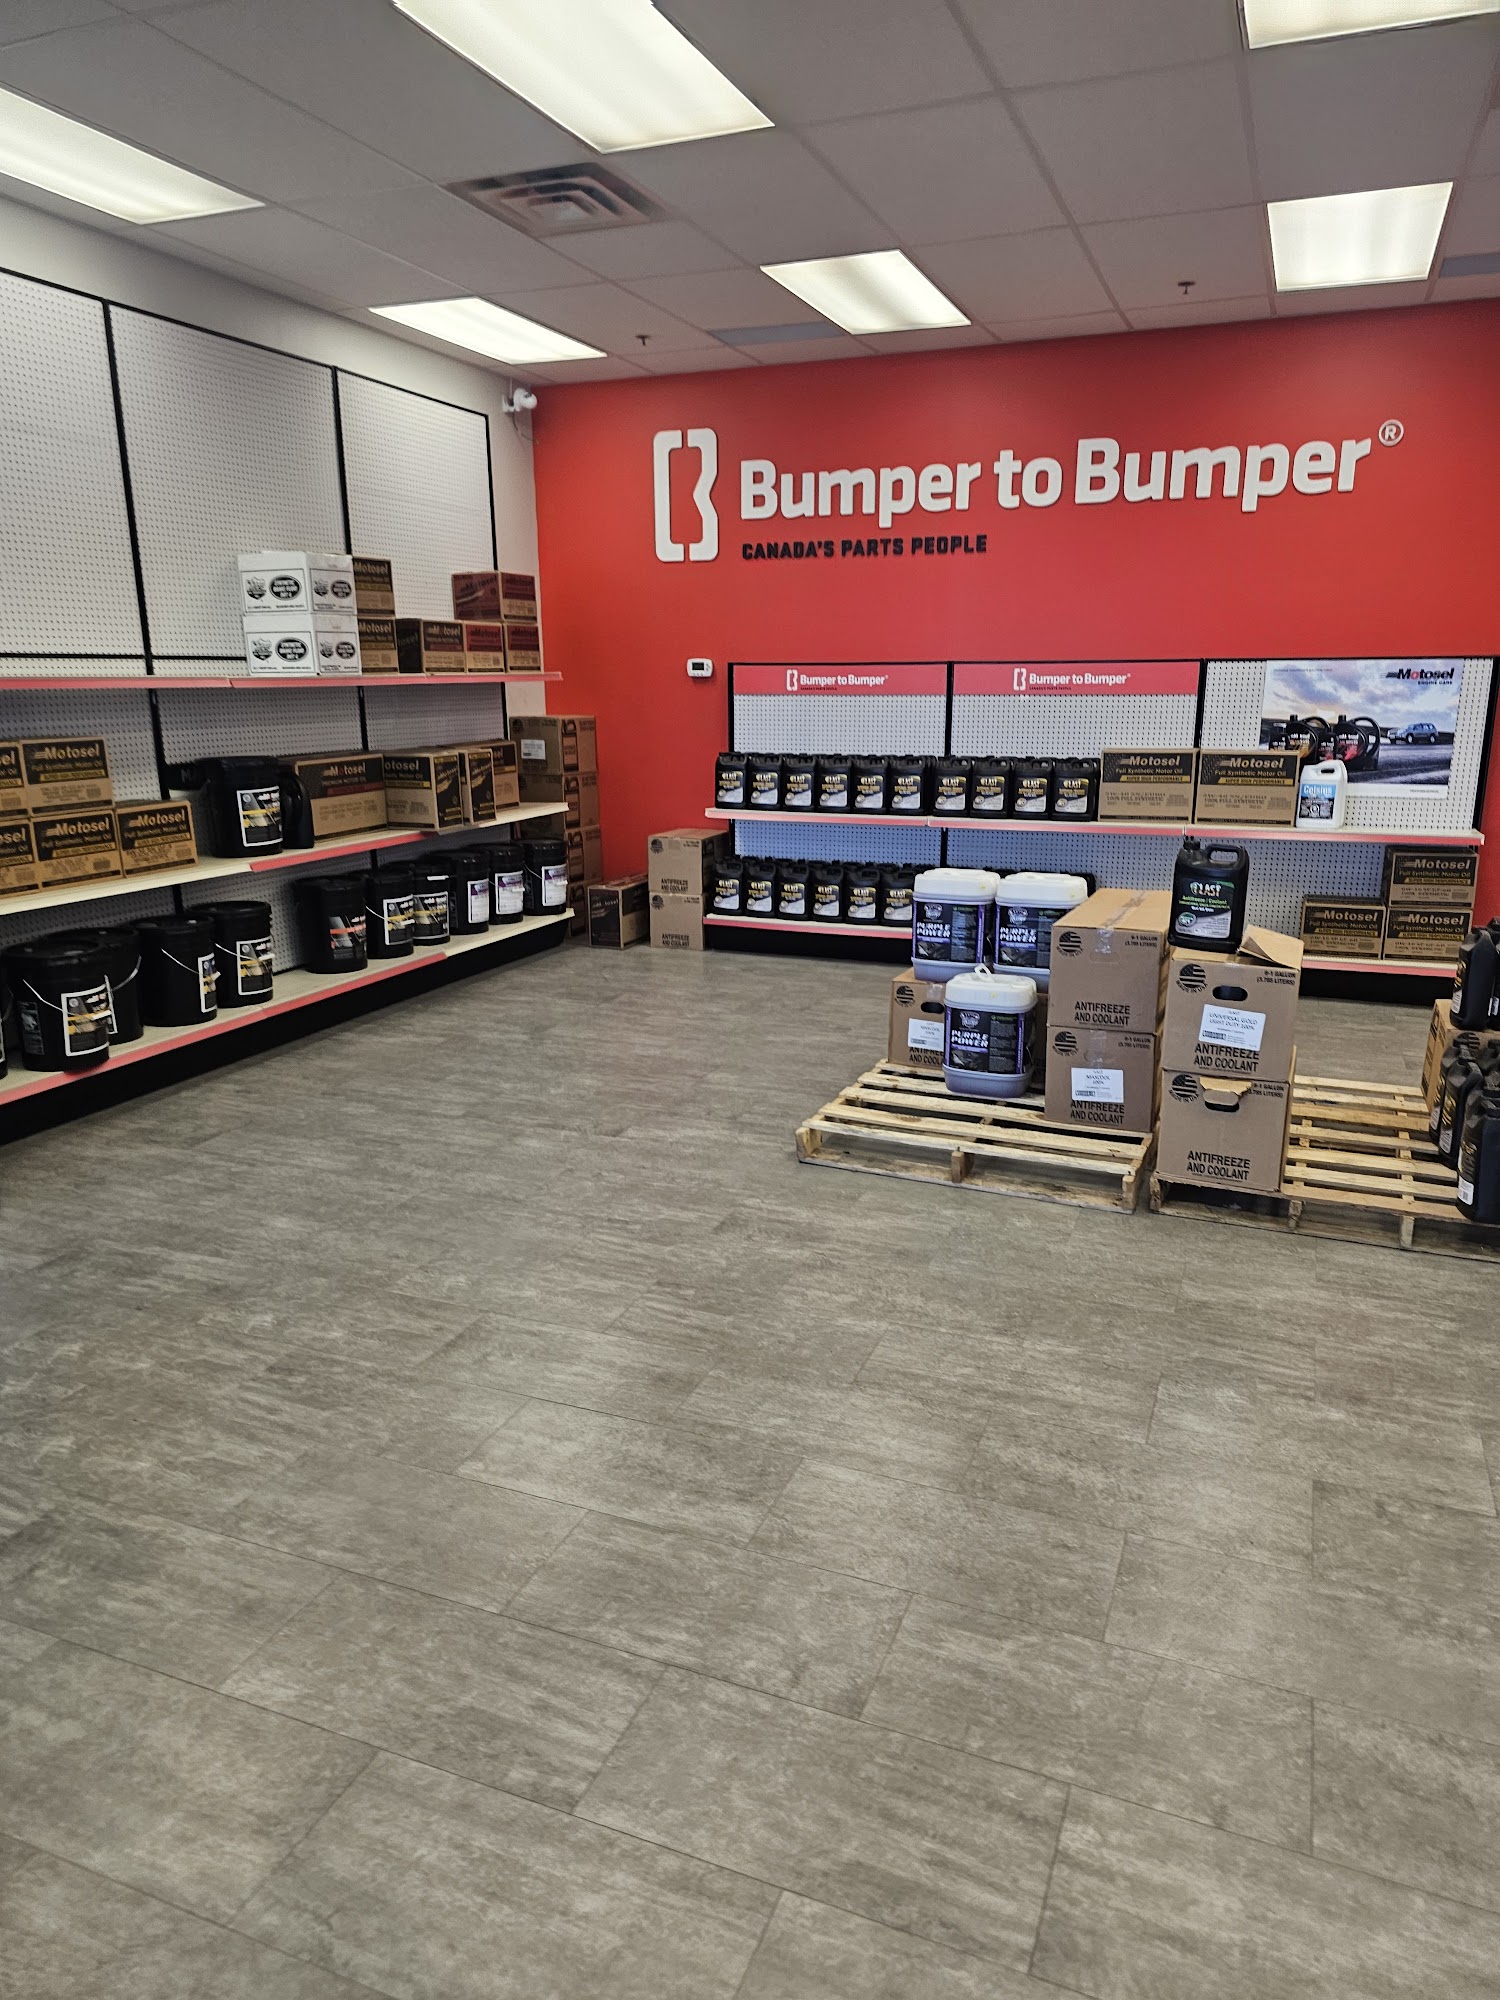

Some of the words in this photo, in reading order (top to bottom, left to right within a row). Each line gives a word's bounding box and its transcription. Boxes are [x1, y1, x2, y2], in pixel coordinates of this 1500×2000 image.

[741, 458, 981, 529] Bumper
[994, 449, 1062, 509] to
[1075, 437, 1371, 512] Bumper
[742, 540, 834, 560] CANADA'S
[841, 537, 902, 558] PARTS
[911, 534, 987, 554] PEOPLE
[1029, 673, 1070, 686] Bumper
[1072, 674, 1083, 684] to
[1084, 673, 1127, 686] Bumper
[1397, 667, 1454, 679] Motosel
[800, 674, 836, 687] Bumper
[837, 675, 847, 685] to
[848, 674, 885, 687] Bumper
[44, 744, 99, 759] Motosel
[385, 760, 419, 770] otosel
[1130, 756, 1180, 766] Motosel
[1230, 758, 1284, 768] Motosel
[138, 809, 185, 826] Motosel
[56, 817, 110, 835] Motosel
[1414, 859, 1471, 869] Motosel
[1324, 910, 1378, 921] Motosel
[1408, 914, 1464, 925] Motosel
[917, 929, 950, 937] POWER
[1000, 934, 1036, 942] POWER
[1075, 1001, 1130, 1015] ANTIFREEZE
[1074, 1012, 1090, 1021] AND
[1092, 1014, 1129, 1026] COOLANT
[951, 1030, 989, 1040] PURPLE
[951, 1036, 989, 1047] POWER
[909, 1054, 922, 1062] AND
[1195, 1043, 1259, 1060] ANTIFREEZE
[1194, 1055, 1213, 1066] AND
[1215, 1057, 1258, 1072] COOLANT
[1070, 1100, 1125, 1114] ANTIFREEZE
[1071, 1110, 1086, 1119] AND
[1088, 1112, 1124, 1124] COOLANT
[1187, 1150, 1250, 1169] ANTIFREEZE
[1187, 1162, 1205, 1173] AND
[1208, 1165, 1249, 1180] COOLANT
